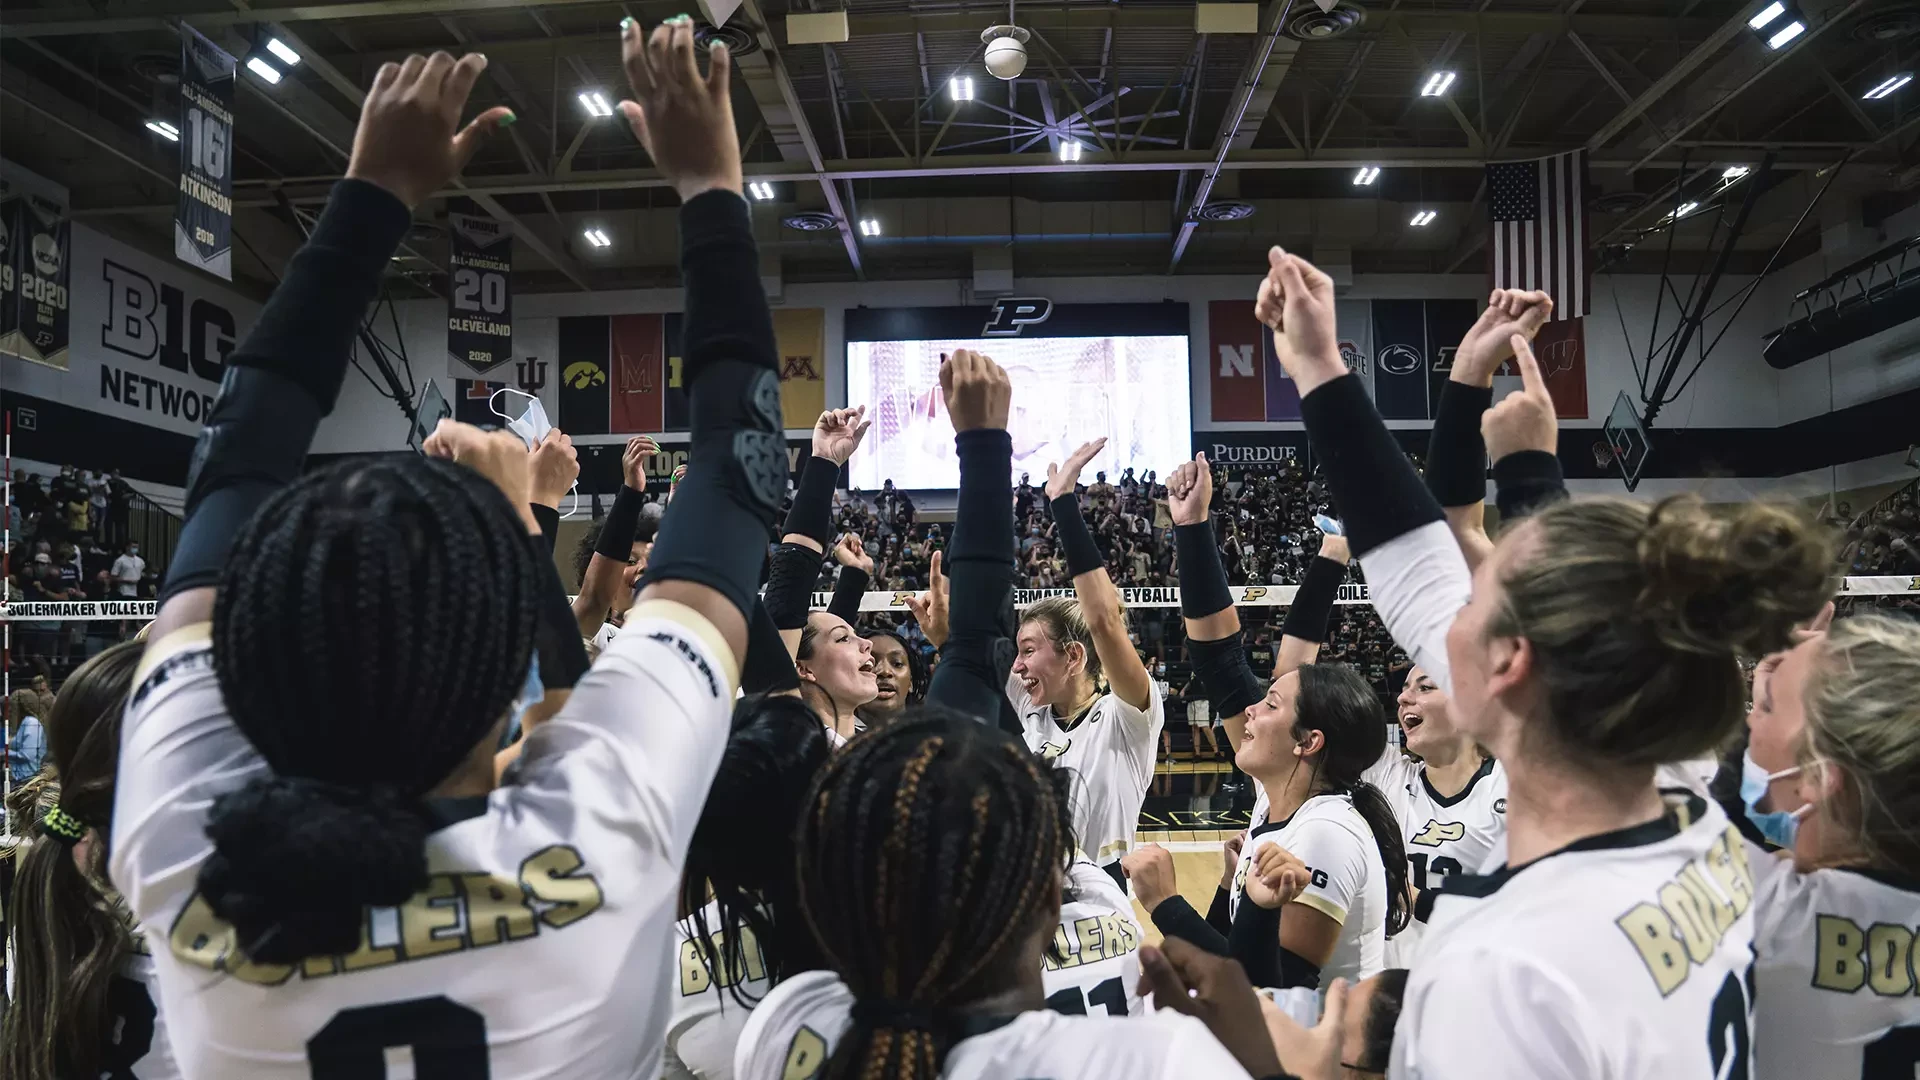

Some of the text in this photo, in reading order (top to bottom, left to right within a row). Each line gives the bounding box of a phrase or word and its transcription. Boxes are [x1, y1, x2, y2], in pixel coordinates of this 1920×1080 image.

[182, 83, 233, 126] ALL-AMERICAN
[189, 108, 224, 179] 16
[180, 173, 232, 216] ATKINSON
[450, 254, 510, 272] ALL-AMERICAN
[22, 272, 67, 310] 2020
[455, 268, 505, 314] 20
[449, 318, 511, 337] CLEVELAND
[469, 351, 492, 362] 2020
[1218, 344, 1255, 377] N
[1212, 444, 1297, 461] PURDUE
[1120, 588, 1178, 603] EYBALL
[8, 602, 96, 617] BOILERMAKER
